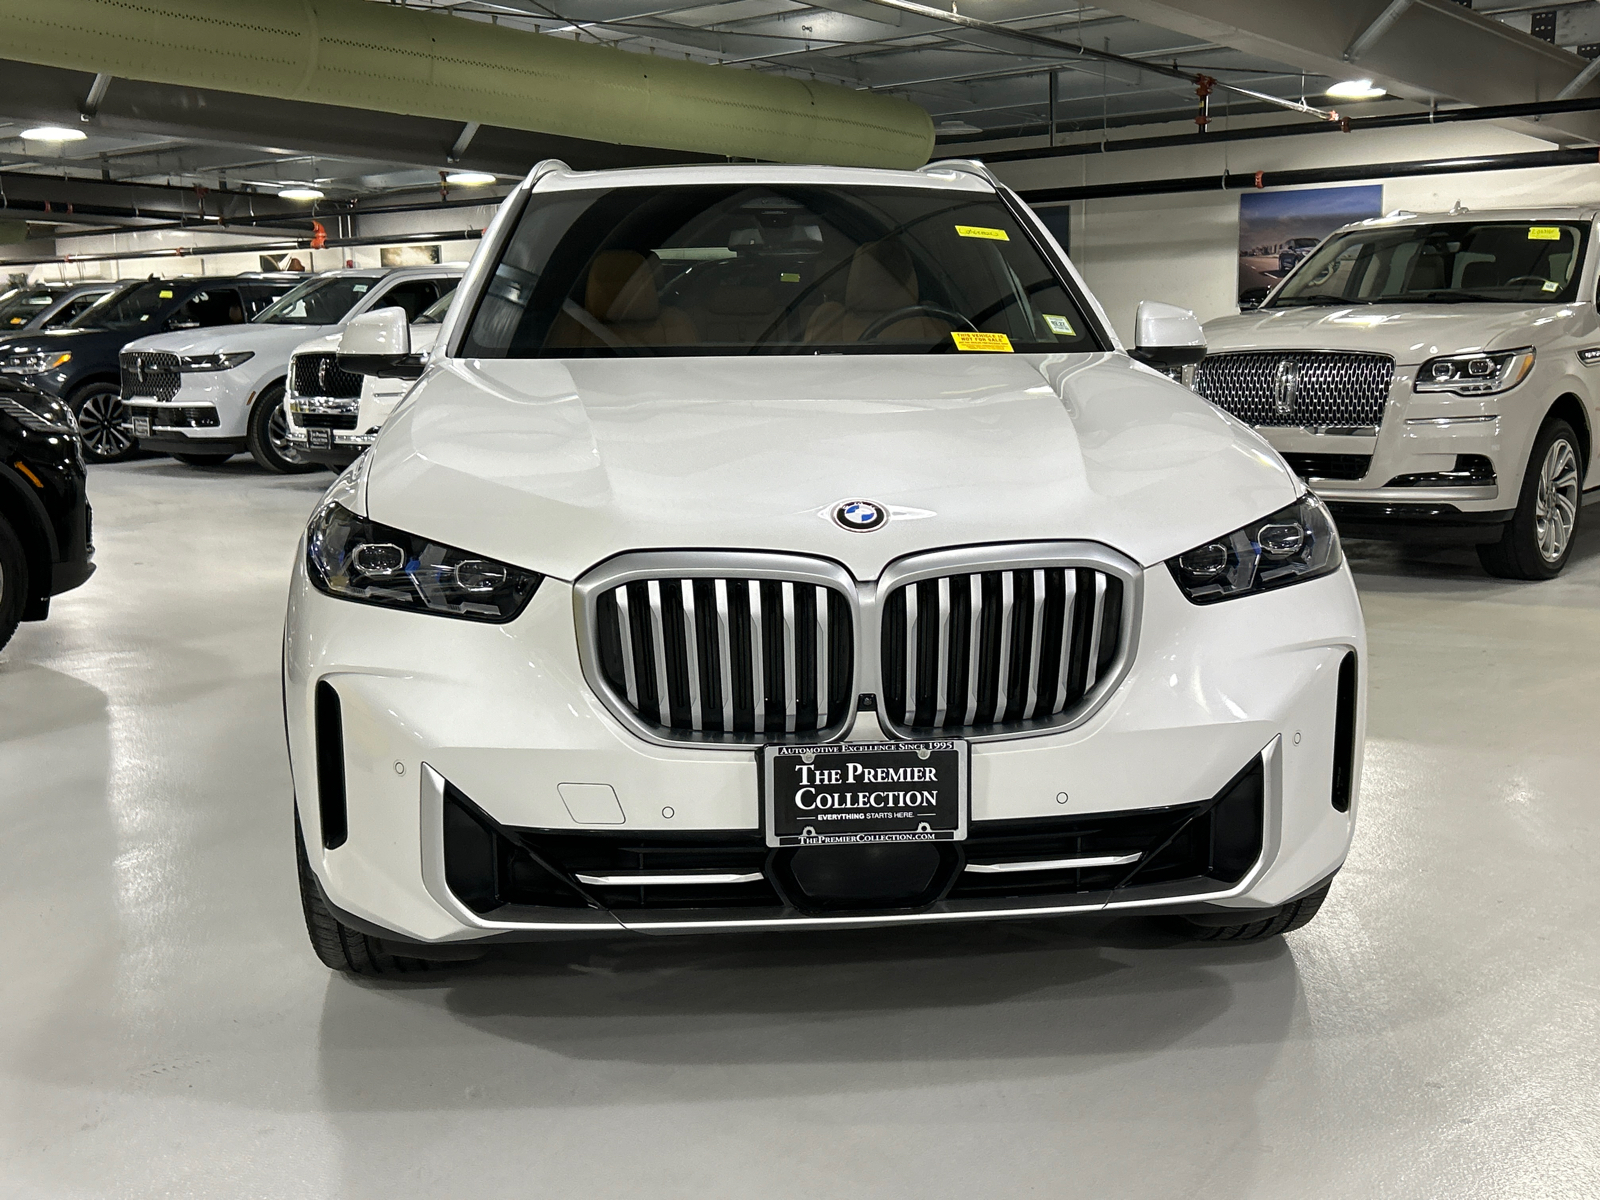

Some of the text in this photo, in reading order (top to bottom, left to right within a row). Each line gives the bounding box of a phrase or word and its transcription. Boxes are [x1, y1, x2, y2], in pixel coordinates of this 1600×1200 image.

[780, 746, 839, 755] AUTOMOTIVE
[841, 744, 896, 752] EXCELLENCE
[929, 742, 953, 750] 1995
[795, 763, 938, 785] THE PREMIER
[795, 787, 938, 810] COLLECTION
[817, 813, 865, 821] EVERYTHING
